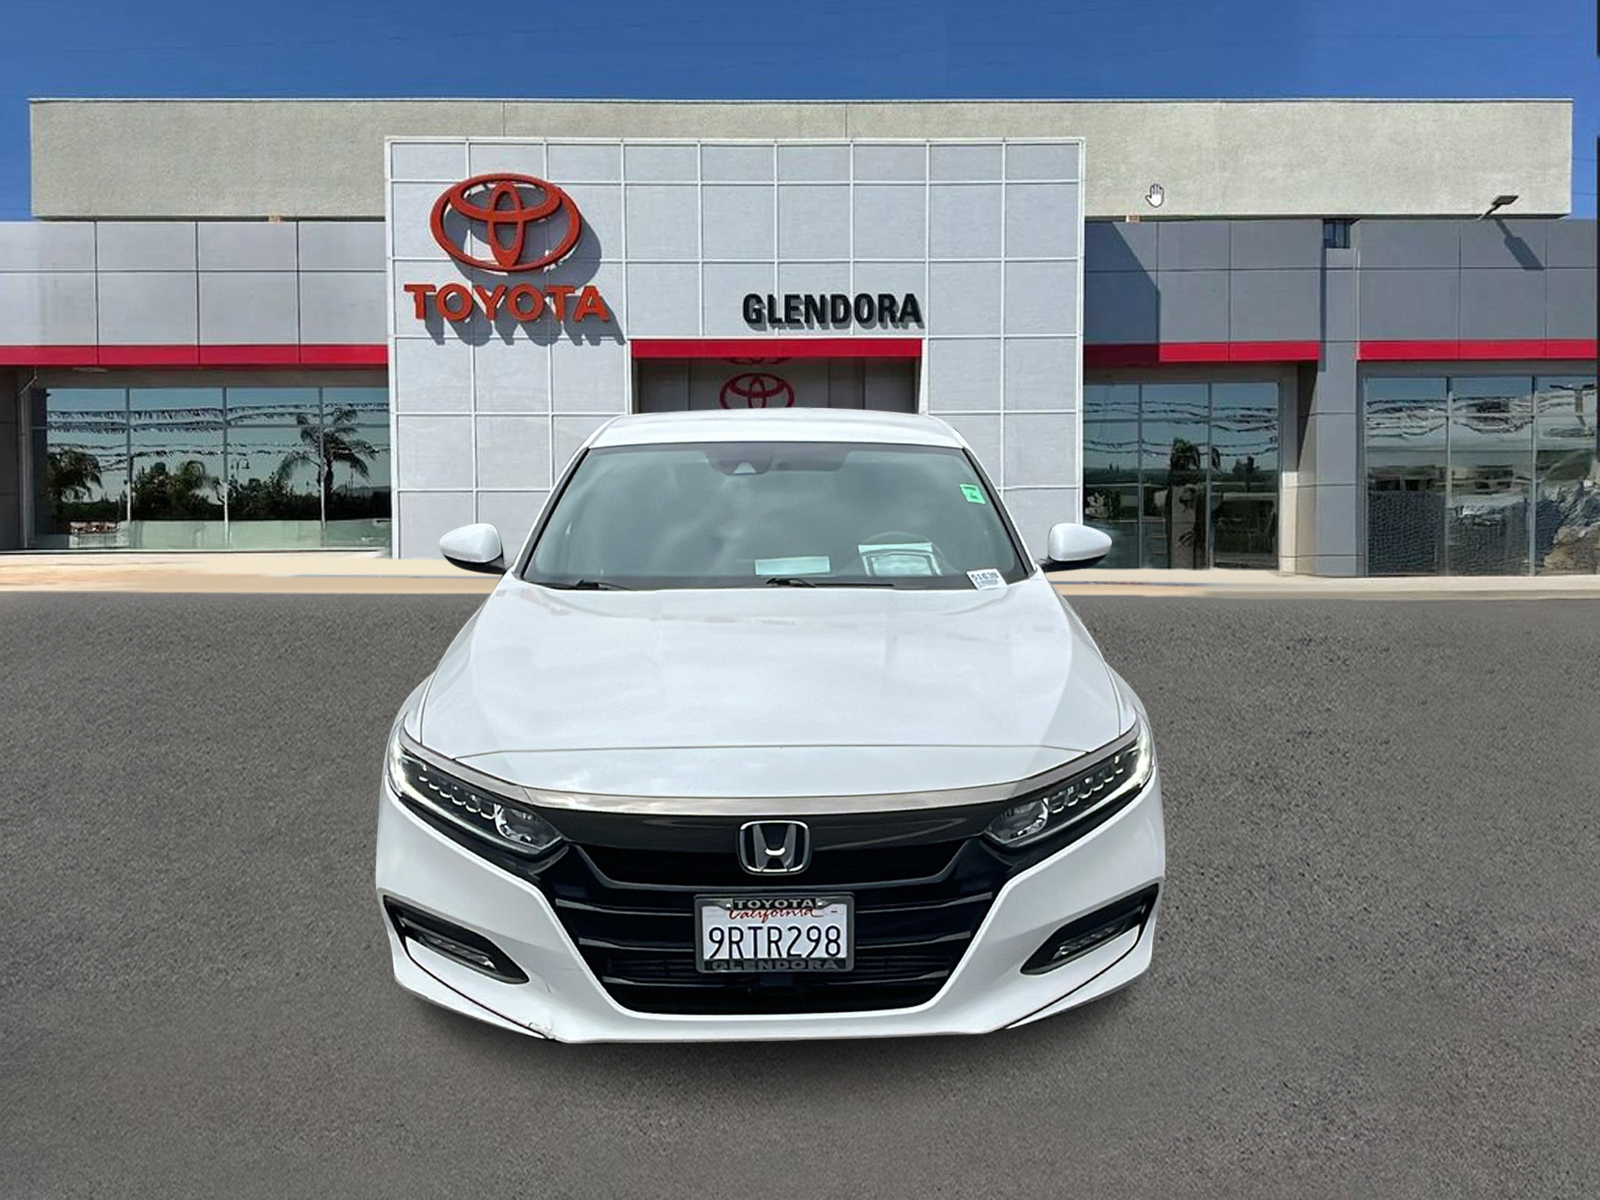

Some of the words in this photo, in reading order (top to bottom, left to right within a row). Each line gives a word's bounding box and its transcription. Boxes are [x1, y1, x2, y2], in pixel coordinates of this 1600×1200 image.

[403, 282, 610, 322] TOYOTA
[742, 293, 923, 326] GLENDORA
[728, 908, 824, 923] California
[734, 899, 814, 909] TOYOTA
[708, 925, 841, 959] 9RTR298
[711, 958, 839, 971] GLENDORA
